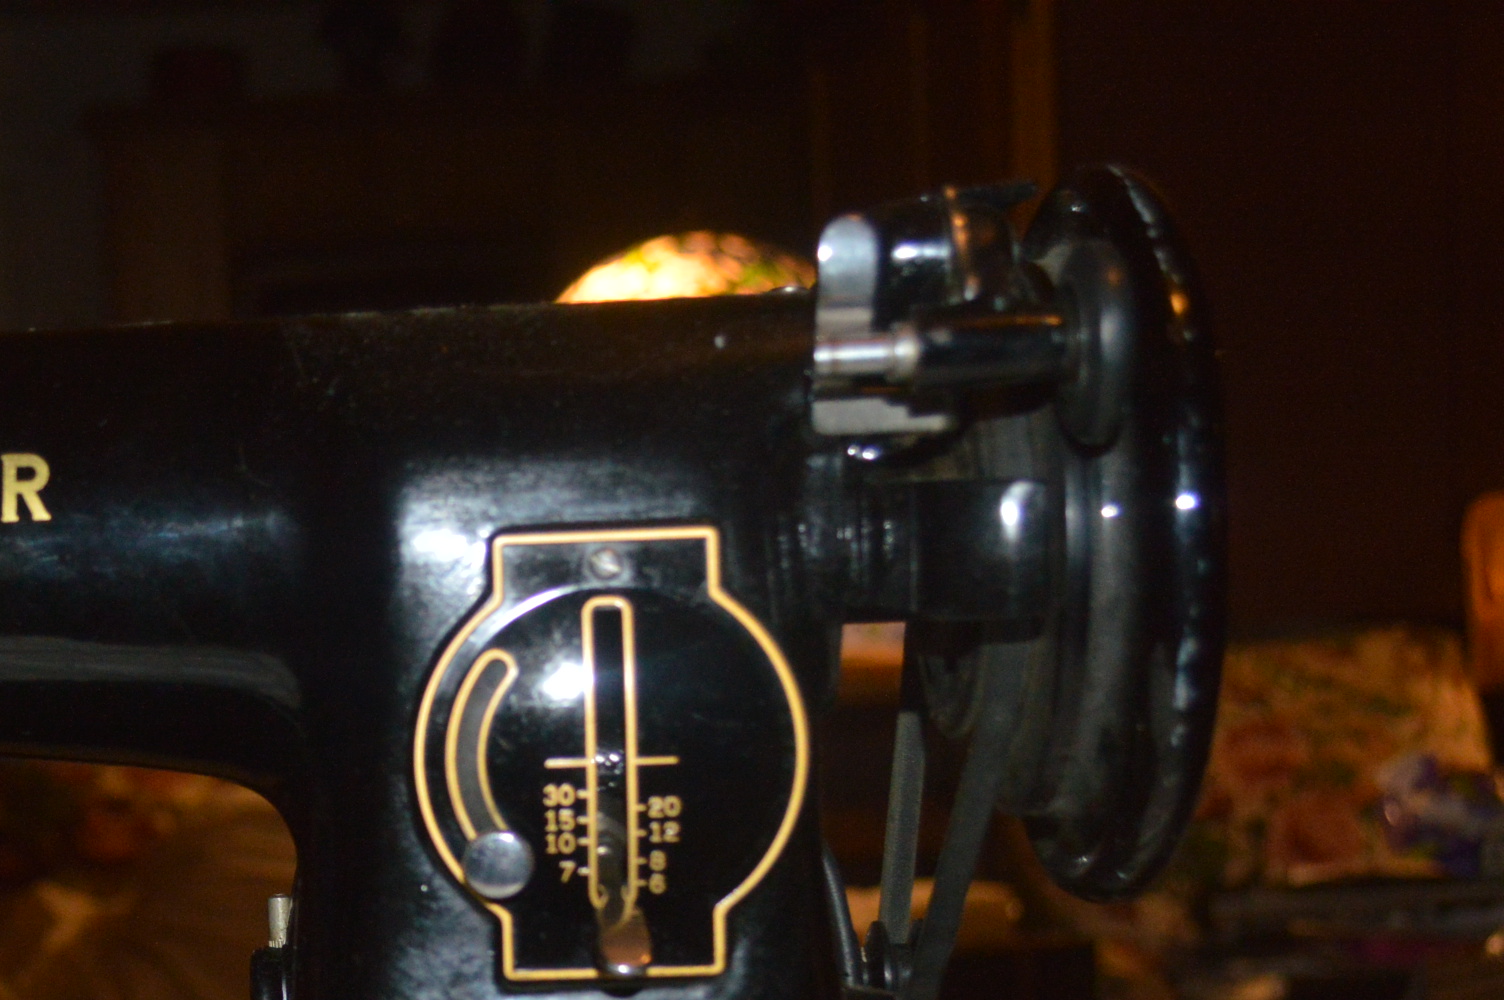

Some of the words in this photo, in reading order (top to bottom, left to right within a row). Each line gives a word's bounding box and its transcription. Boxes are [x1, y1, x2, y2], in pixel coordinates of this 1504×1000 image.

[543, 783, 576, 807] 30
[647, 795, 682, 818] 20
[544, 808, 576, 832] 15
[544, 832, 577, 855] 10
[649, 821, 681, 843] 12
[559, 860, 576, 883] 7
